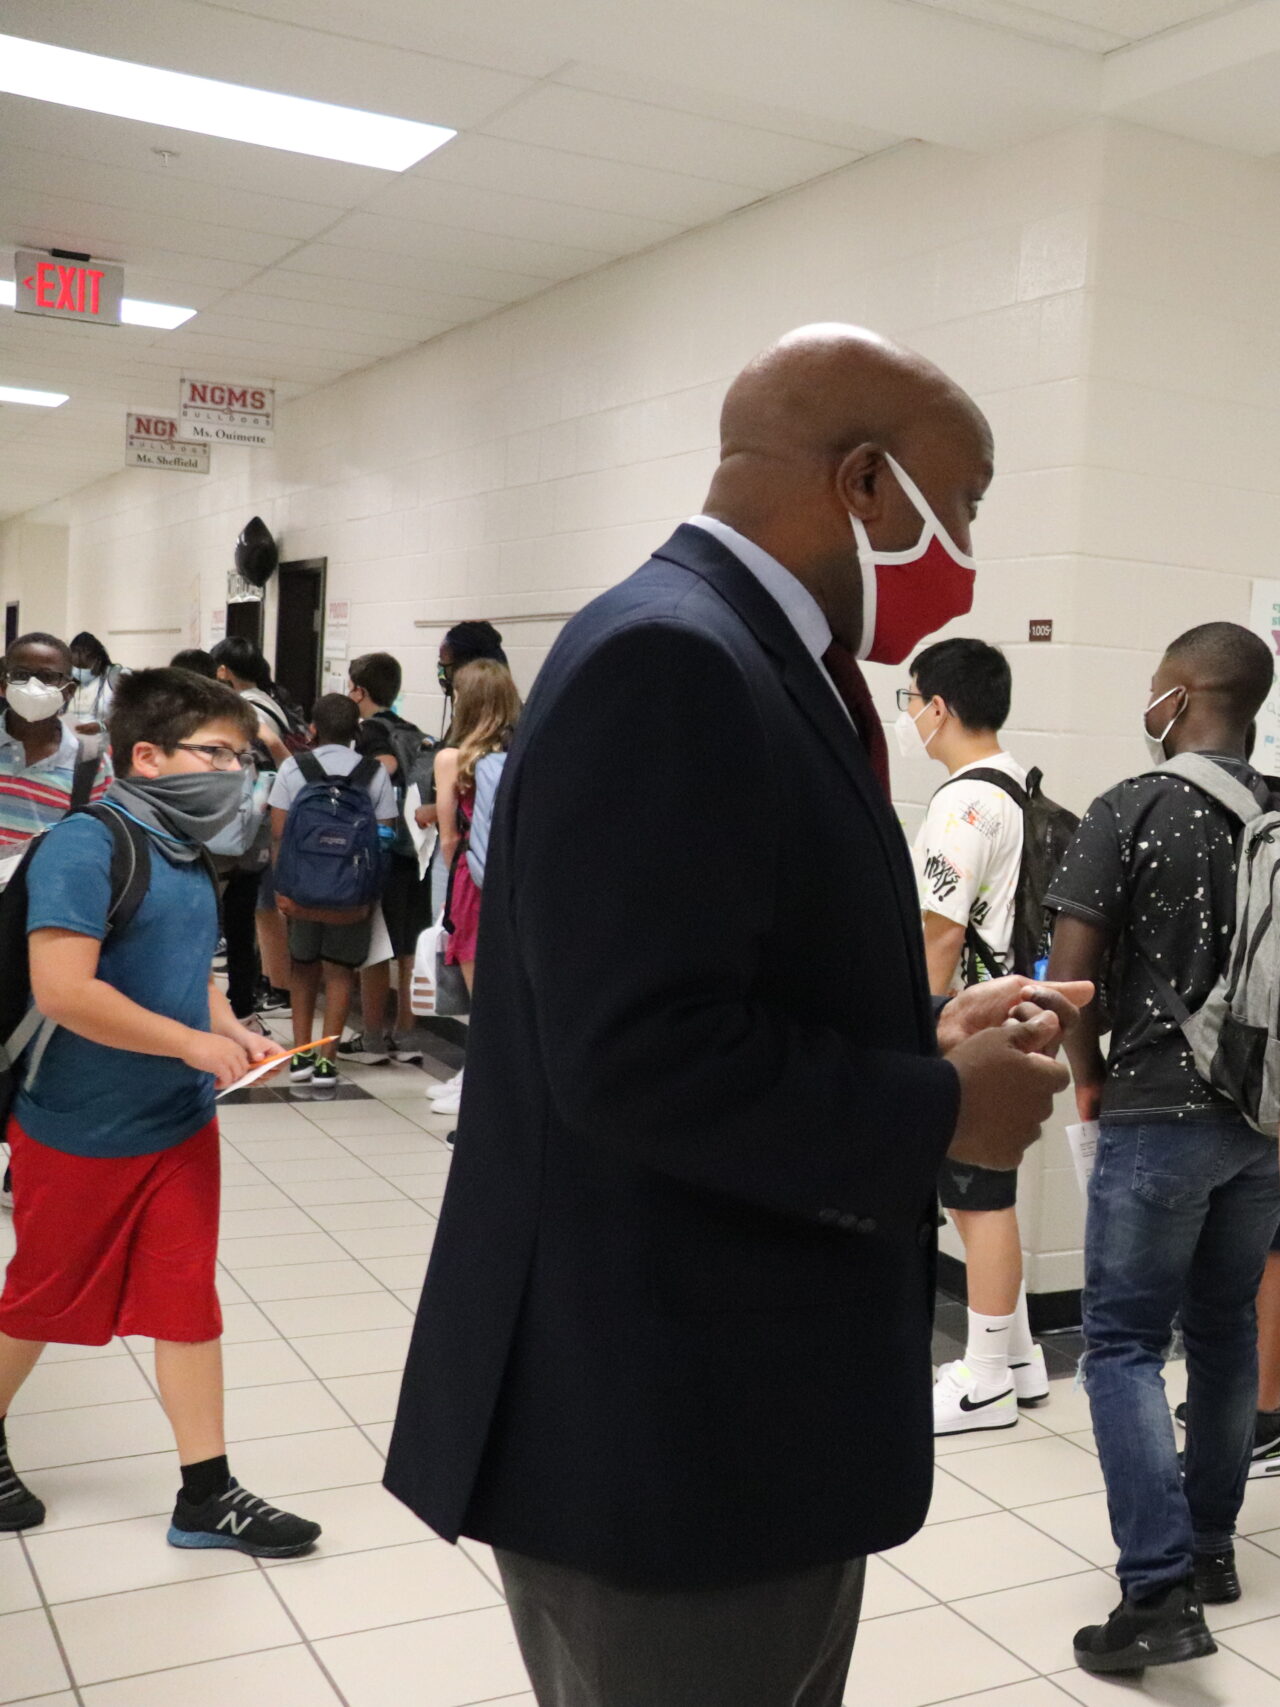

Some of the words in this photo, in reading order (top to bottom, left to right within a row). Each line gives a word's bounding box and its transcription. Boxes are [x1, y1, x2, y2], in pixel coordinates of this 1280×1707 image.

[36, 262, 105, 315] EXIT
[190, 383, 266, 410] NGMS
[182, 410, 271, 426] BULLDOGS
[193, 426, 212, 438] Ms.
[156, 455, 199, 468] Sheffield
